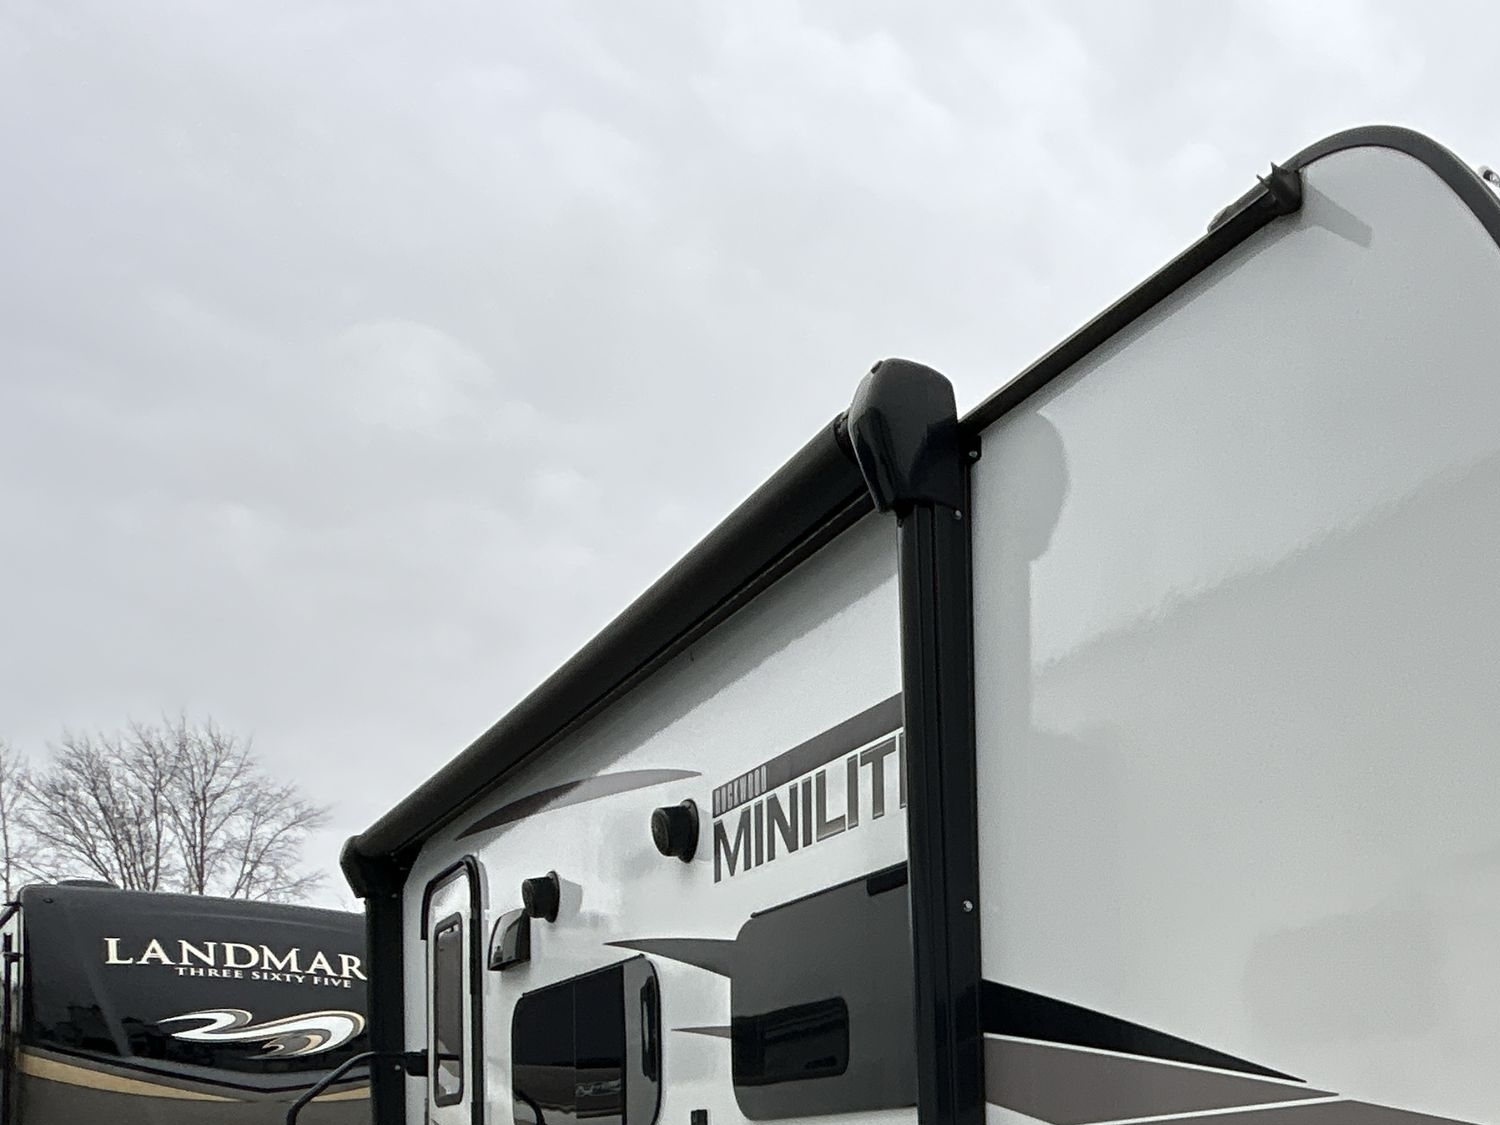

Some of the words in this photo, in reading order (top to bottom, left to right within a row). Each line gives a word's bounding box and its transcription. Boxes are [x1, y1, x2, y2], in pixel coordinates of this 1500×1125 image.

[713, 732, 908, 884] MINILIT
[174, 966, 243, 980] THREE
[251, 970, 306, 986] SIXTY
[313, 975, 352, 989] FIVE
